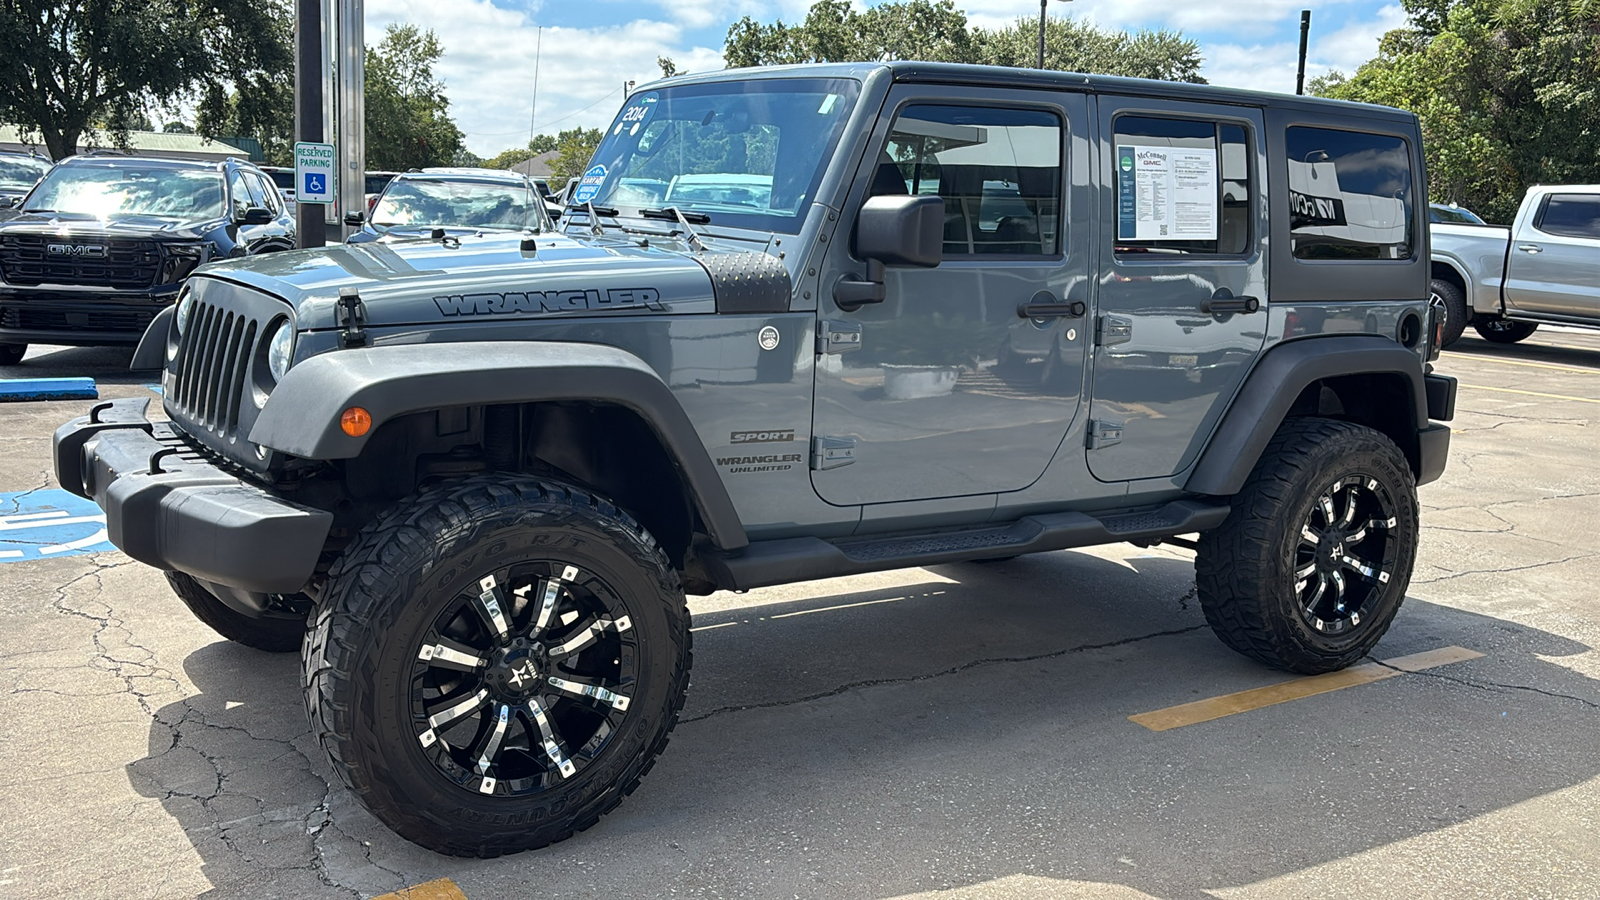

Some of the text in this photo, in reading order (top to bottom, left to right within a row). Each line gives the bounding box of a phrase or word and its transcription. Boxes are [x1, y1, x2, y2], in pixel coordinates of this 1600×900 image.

[622, 106, 649, 121] 2014
[297, 148, 333, 158] RESERVED
[1137, 151, 1167, 161] McConnell
[300, 159, 330, 168] PARKING
[48, 244, 106, 257] GMC
[432, 288, 666, 317] WRANGLER
[733, 431, 794, 442] SPORT
[716, 454, 802, 466] WRANGLER
[730, 464, 792, 473] UNLIMITED
[1371, 458, 1403, 489] OPEN
[416, 534, 588, 614] TOYO R/T
[451, 717, 649, 826] OPEN COUNTRY
